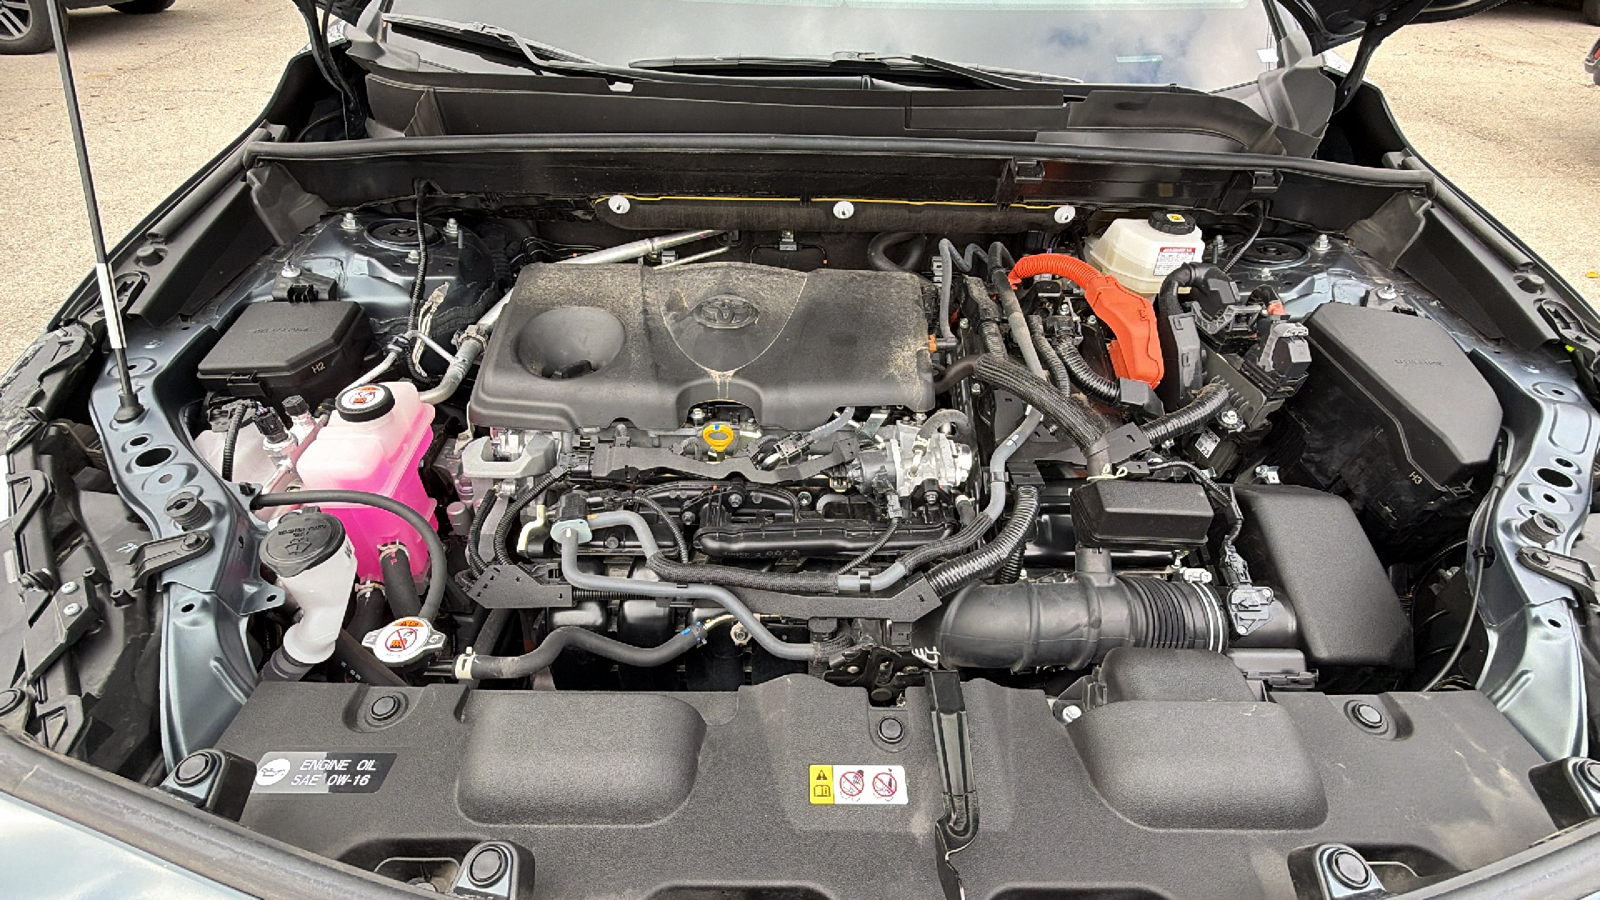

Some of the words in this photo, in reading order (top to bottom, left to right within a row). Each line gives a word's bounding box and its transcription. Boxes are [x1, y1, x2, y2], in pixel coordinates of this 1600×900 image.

[311, 361, 326, 374] H2
[1408, 471, 1423, 485] H3
[300, 759, 351, 771] ENGINE
[356, 759, 377, 771] OIL
[291, 774, 322, 786] SAE
[327, 774, 370, 786] 0W-16
